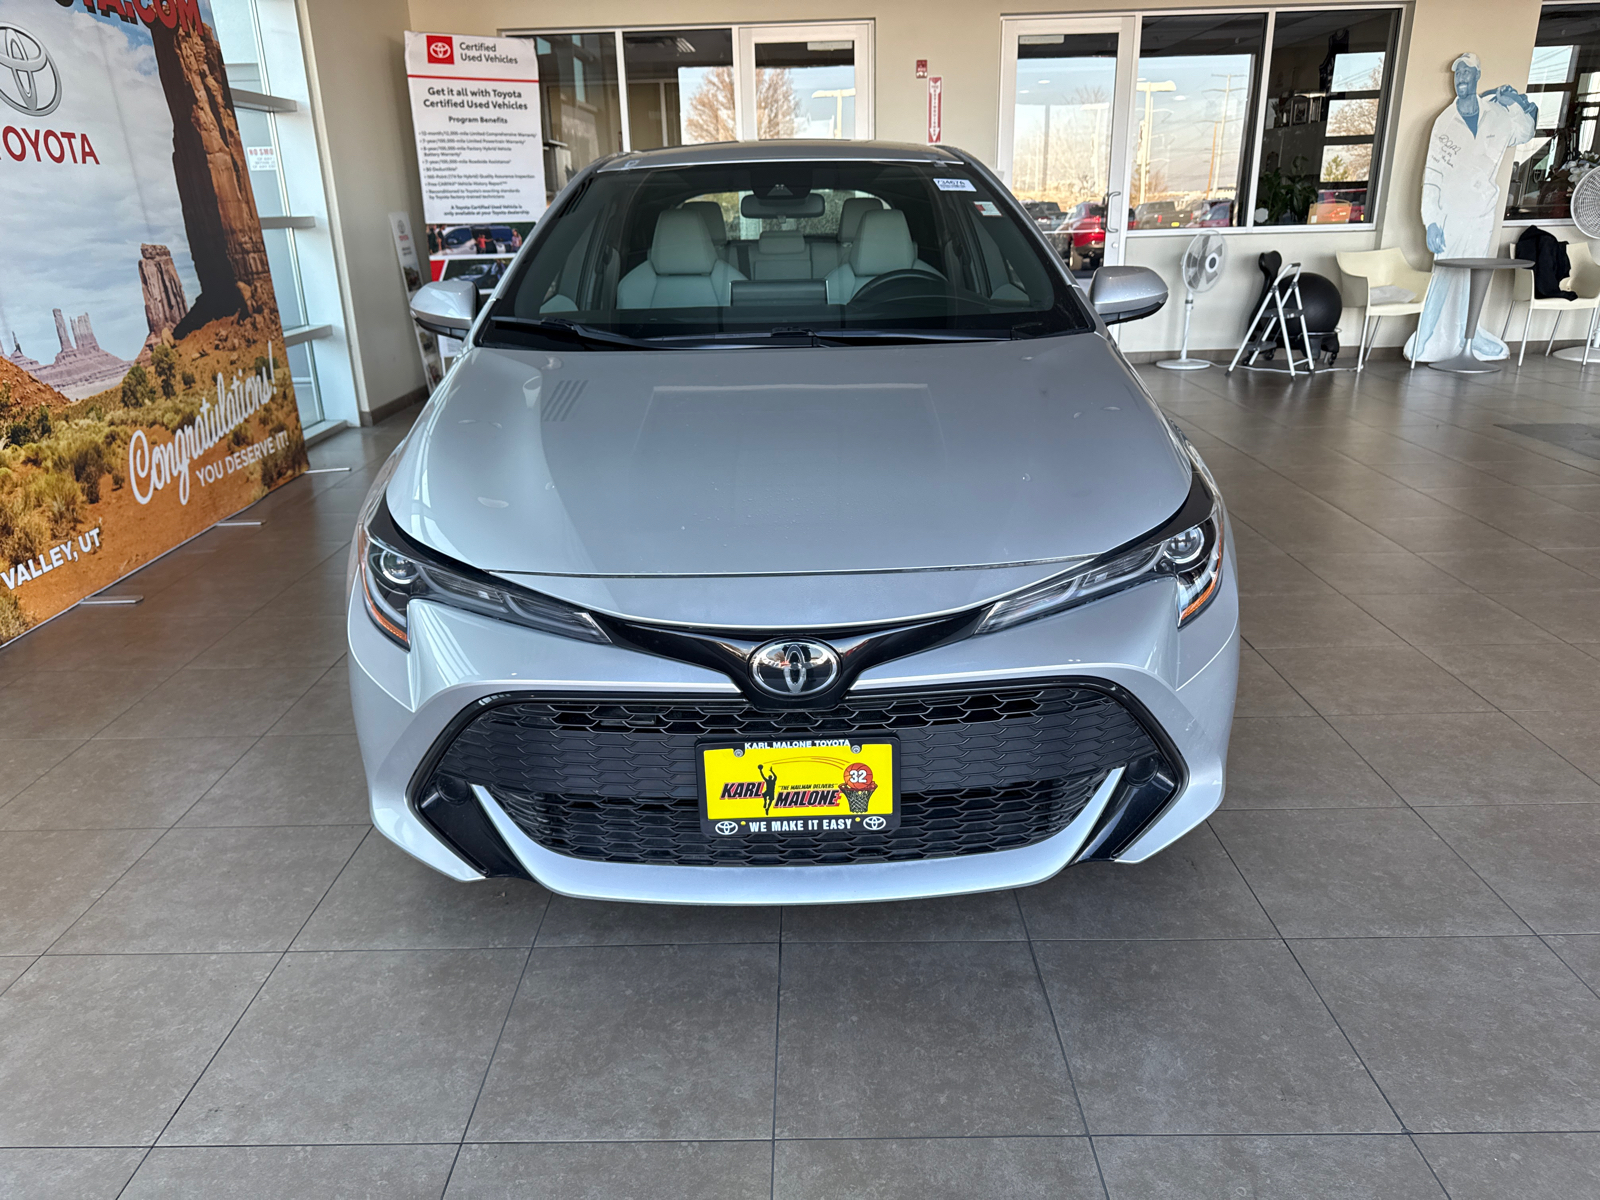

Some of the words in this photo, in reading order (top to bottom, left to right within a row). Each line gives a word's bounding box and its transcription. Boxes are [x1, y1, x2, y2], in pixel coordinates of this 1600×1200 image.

[460, 42, 496, 52] Certified
[461, 53, 481, 62] Used
[484, 54, 518, 64] Vehicles
[428, 87, 445, 96] Get
[447, 87, 454, 96] it
[457, 88, 467, 97] all
[470, 88, 490, 98] with
[493, 89, 522, 100] Toyota
[424, 99, 464, 108] Certified
[467, 100, 489, 109] Used
[492, 101, 527, 110] Vehicles
[448, 116, 478, 125] Program
[0, 126, 100, 164] OYOTA
[129, 341, 278, 505] Congratulations!
[196, 461, 223, 487] YOU
[225, 438, 274, 474] DESERVE
[274, 430, 288, 455] IT!
[0, 541, 78, 590] VALLEY,
[78, 527, 101, 554] UT
[745, 741, 770, 750] KARL
[773, 740, 812, 749] MALONE
[815, 739, 850, 747] TOYOTA
[850, 769, 867, 784] 32
[720, 782, 765, 800] KARL
[773, 789, 842, 808] MALONE
[749, 821, 767, 832] WE
[772, 820, 804, 831] MAKE
[808, 820, 818, 830] IT
[821, 818, 852, 830] EASY
